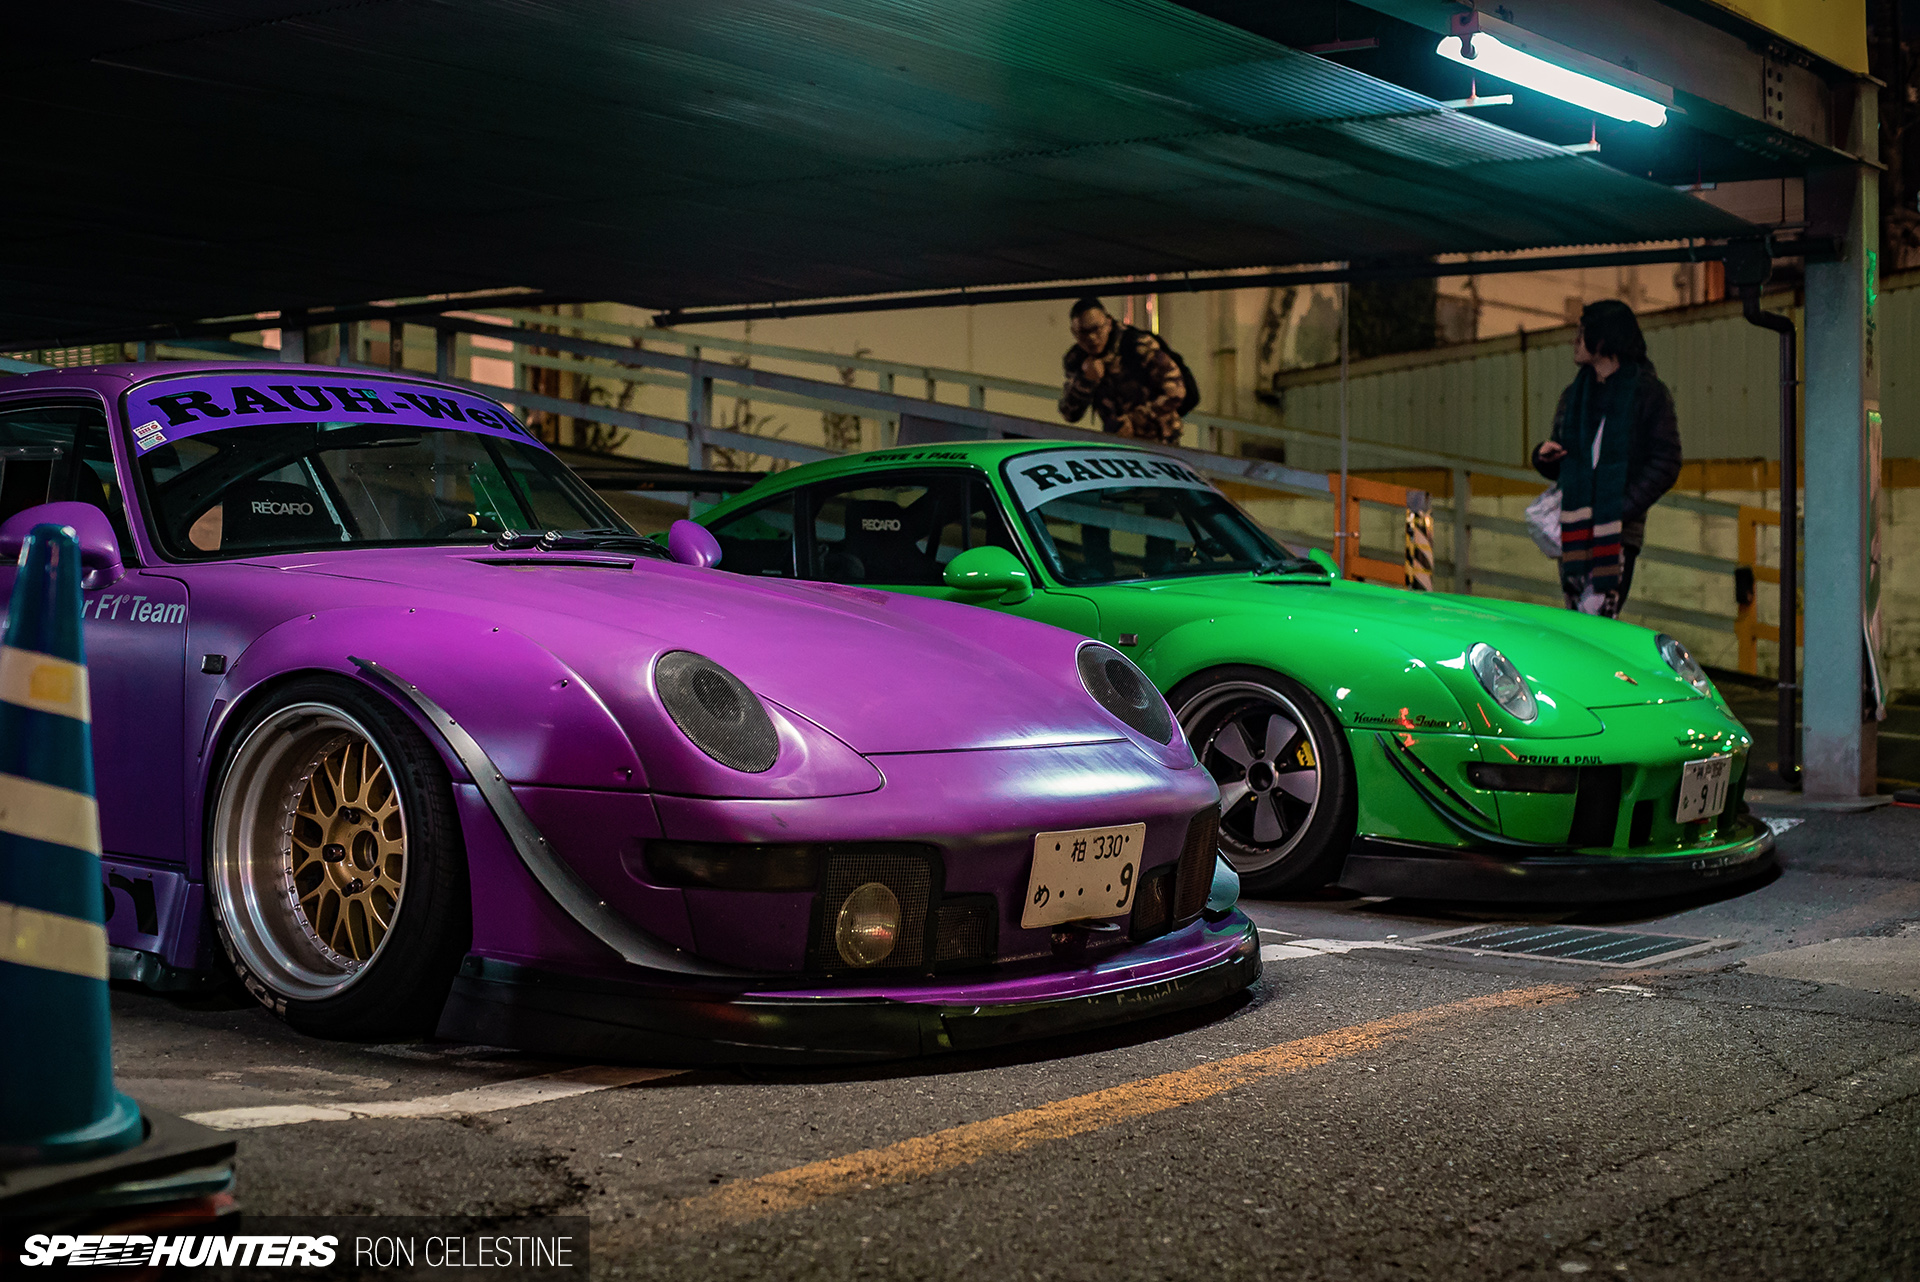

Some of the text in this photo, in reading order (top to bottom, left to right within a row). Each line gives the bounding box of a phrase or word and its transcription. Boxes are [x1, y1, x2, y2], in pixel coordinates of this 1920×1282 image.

[927, 452, 968, 460] PAUL
[251, 501, 314, 516] RECARO
[862, 519, 901, 531] RECARO
[130, 595, 186, 624] Team
[1518, 755, 1603, 764] DRIVE 4 PAUL
[1698, 780, 1726, 815] 911
[1071, 834, 1124, 862] 柏 330
